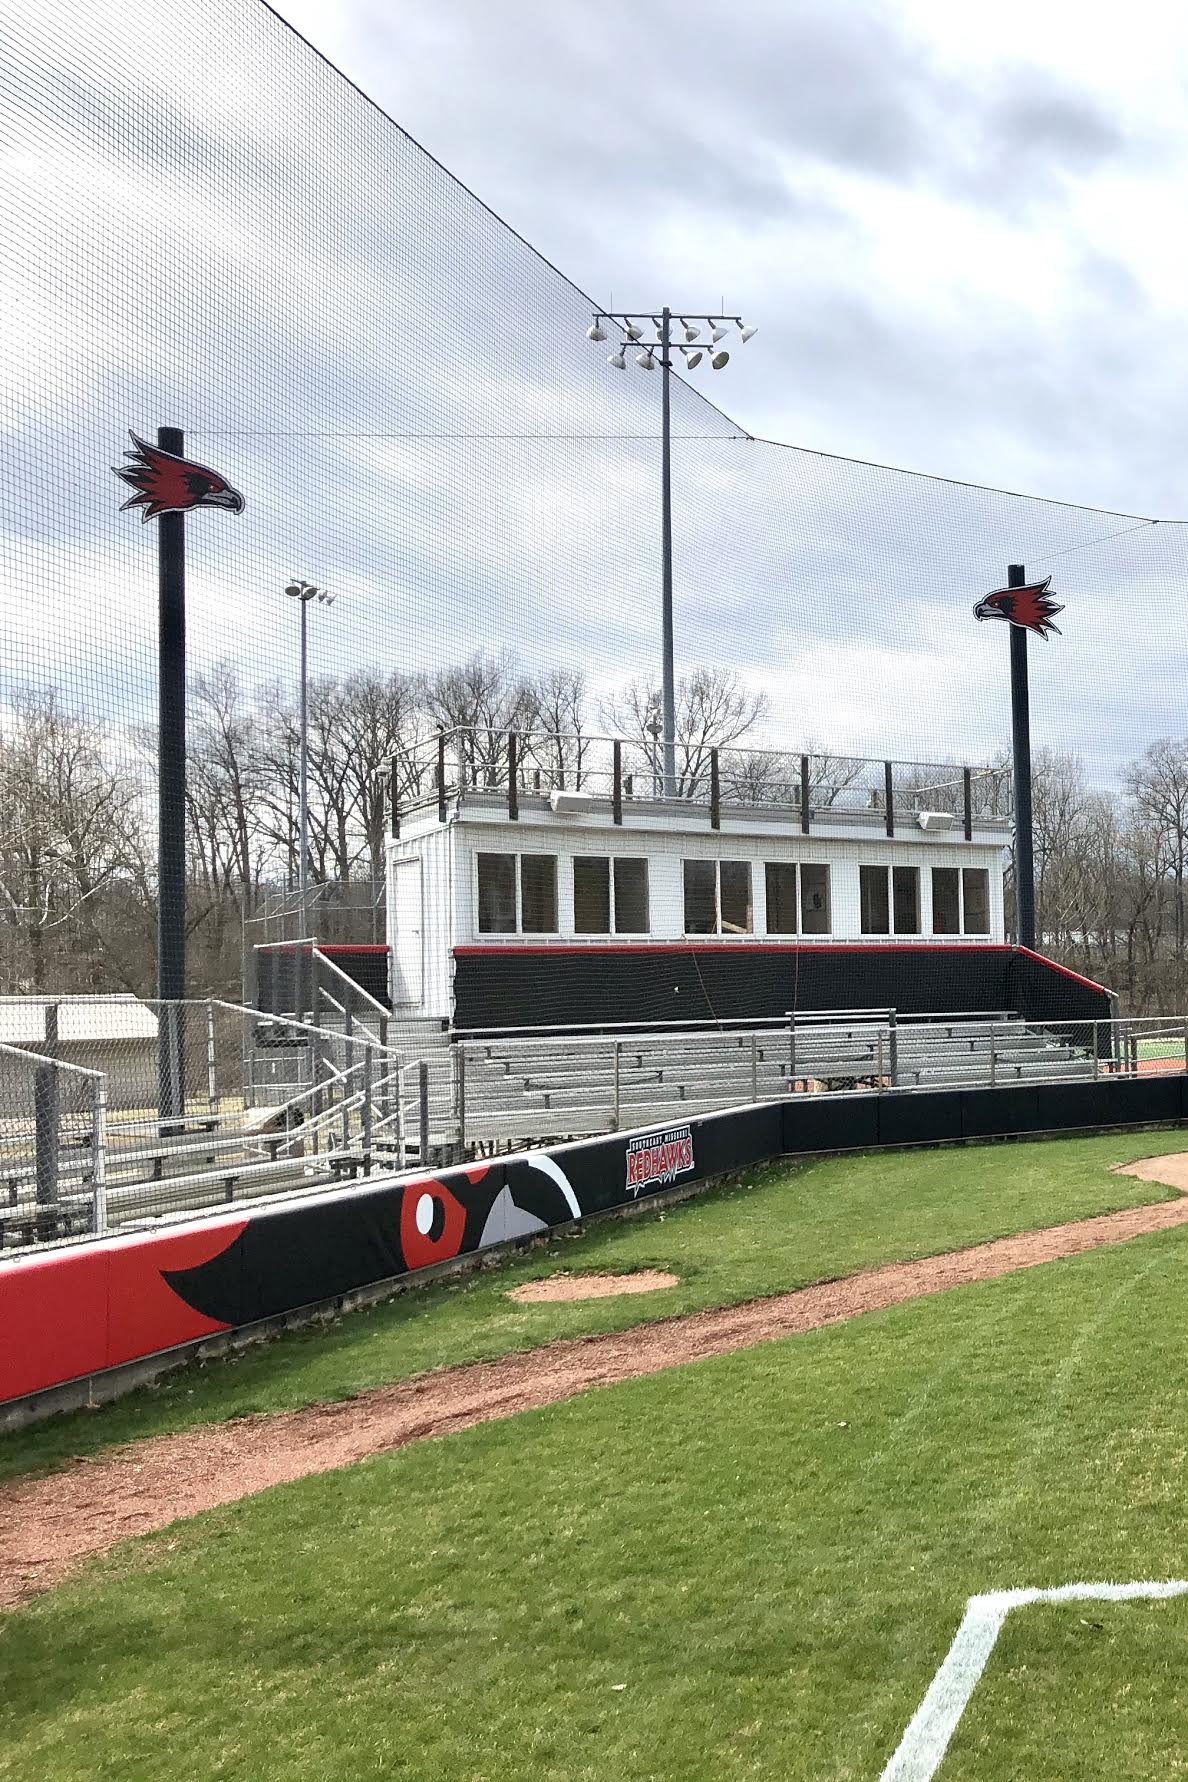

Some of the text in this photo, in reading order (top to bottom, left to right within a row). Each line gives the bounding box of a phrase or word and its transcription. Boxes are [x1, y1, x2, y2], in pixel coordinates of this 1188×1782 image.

[632, 1129, 688, 1151] SOUTHEAST MISSOURI
[628, 1137, 692, 1185] REDHAWKS
